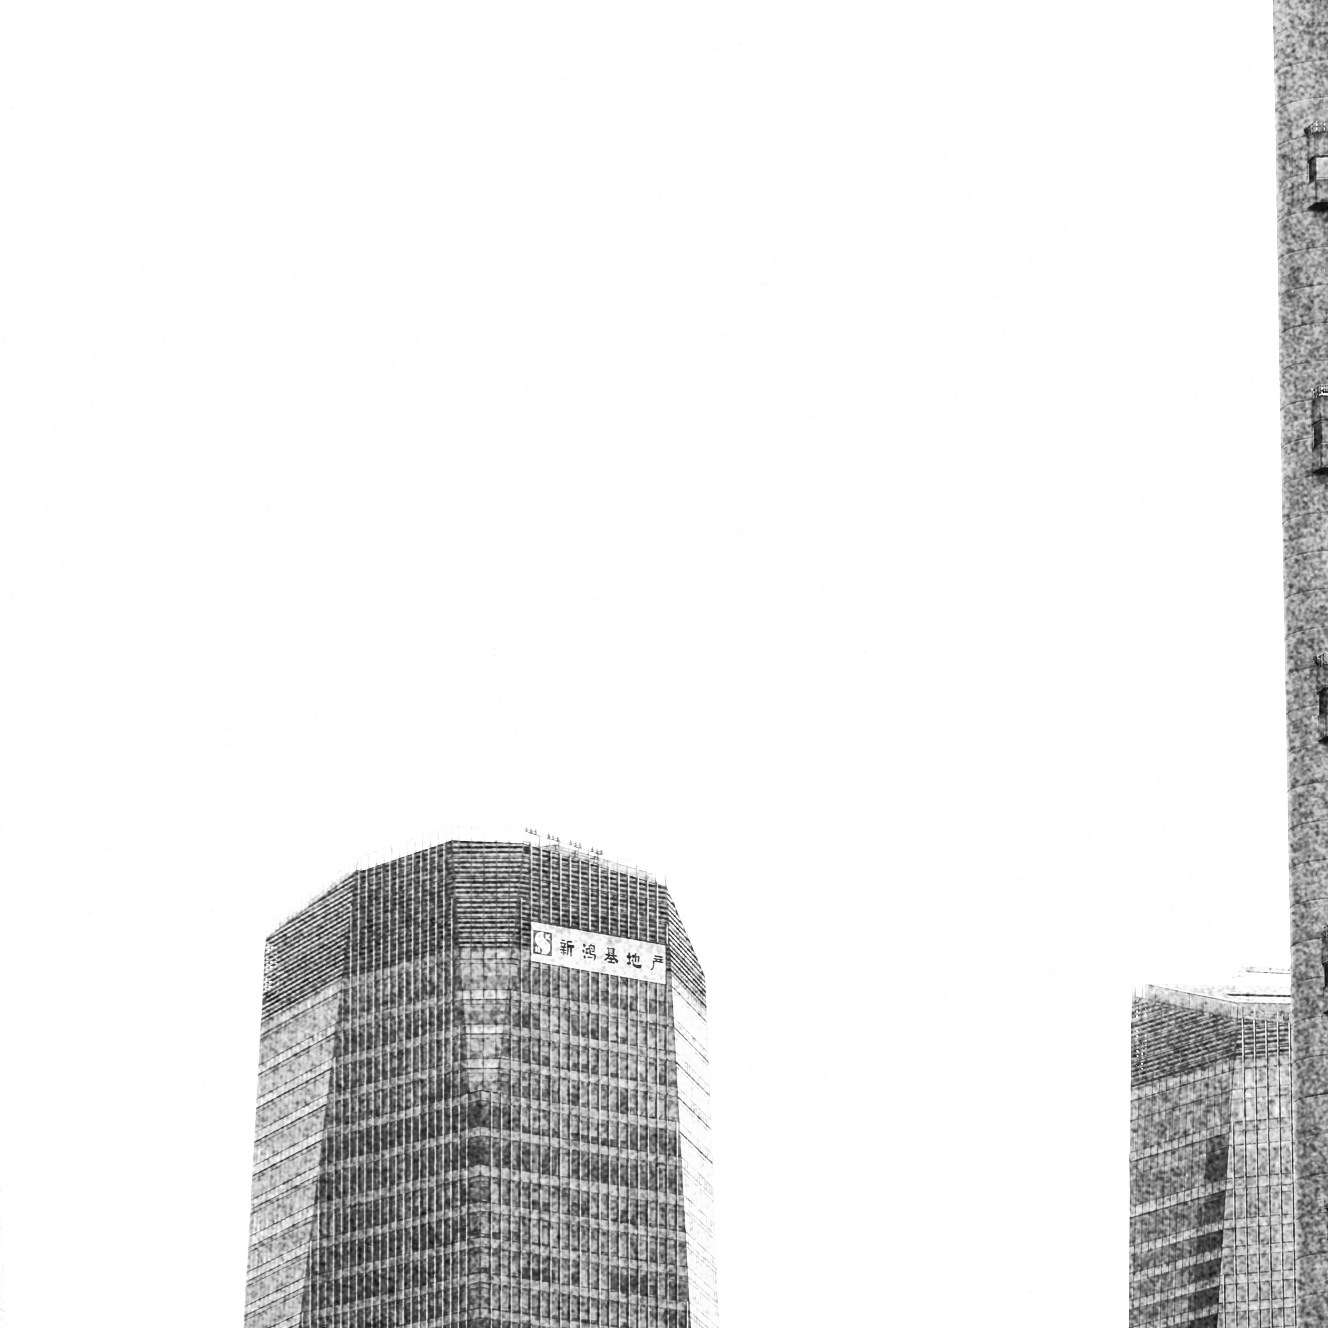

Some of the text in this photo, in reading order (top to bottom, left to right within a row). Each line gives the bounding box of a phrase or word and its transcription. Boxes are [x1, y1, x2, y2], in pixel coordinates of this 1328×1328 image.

[559, 938, 664, 971] 新鸿基地产
